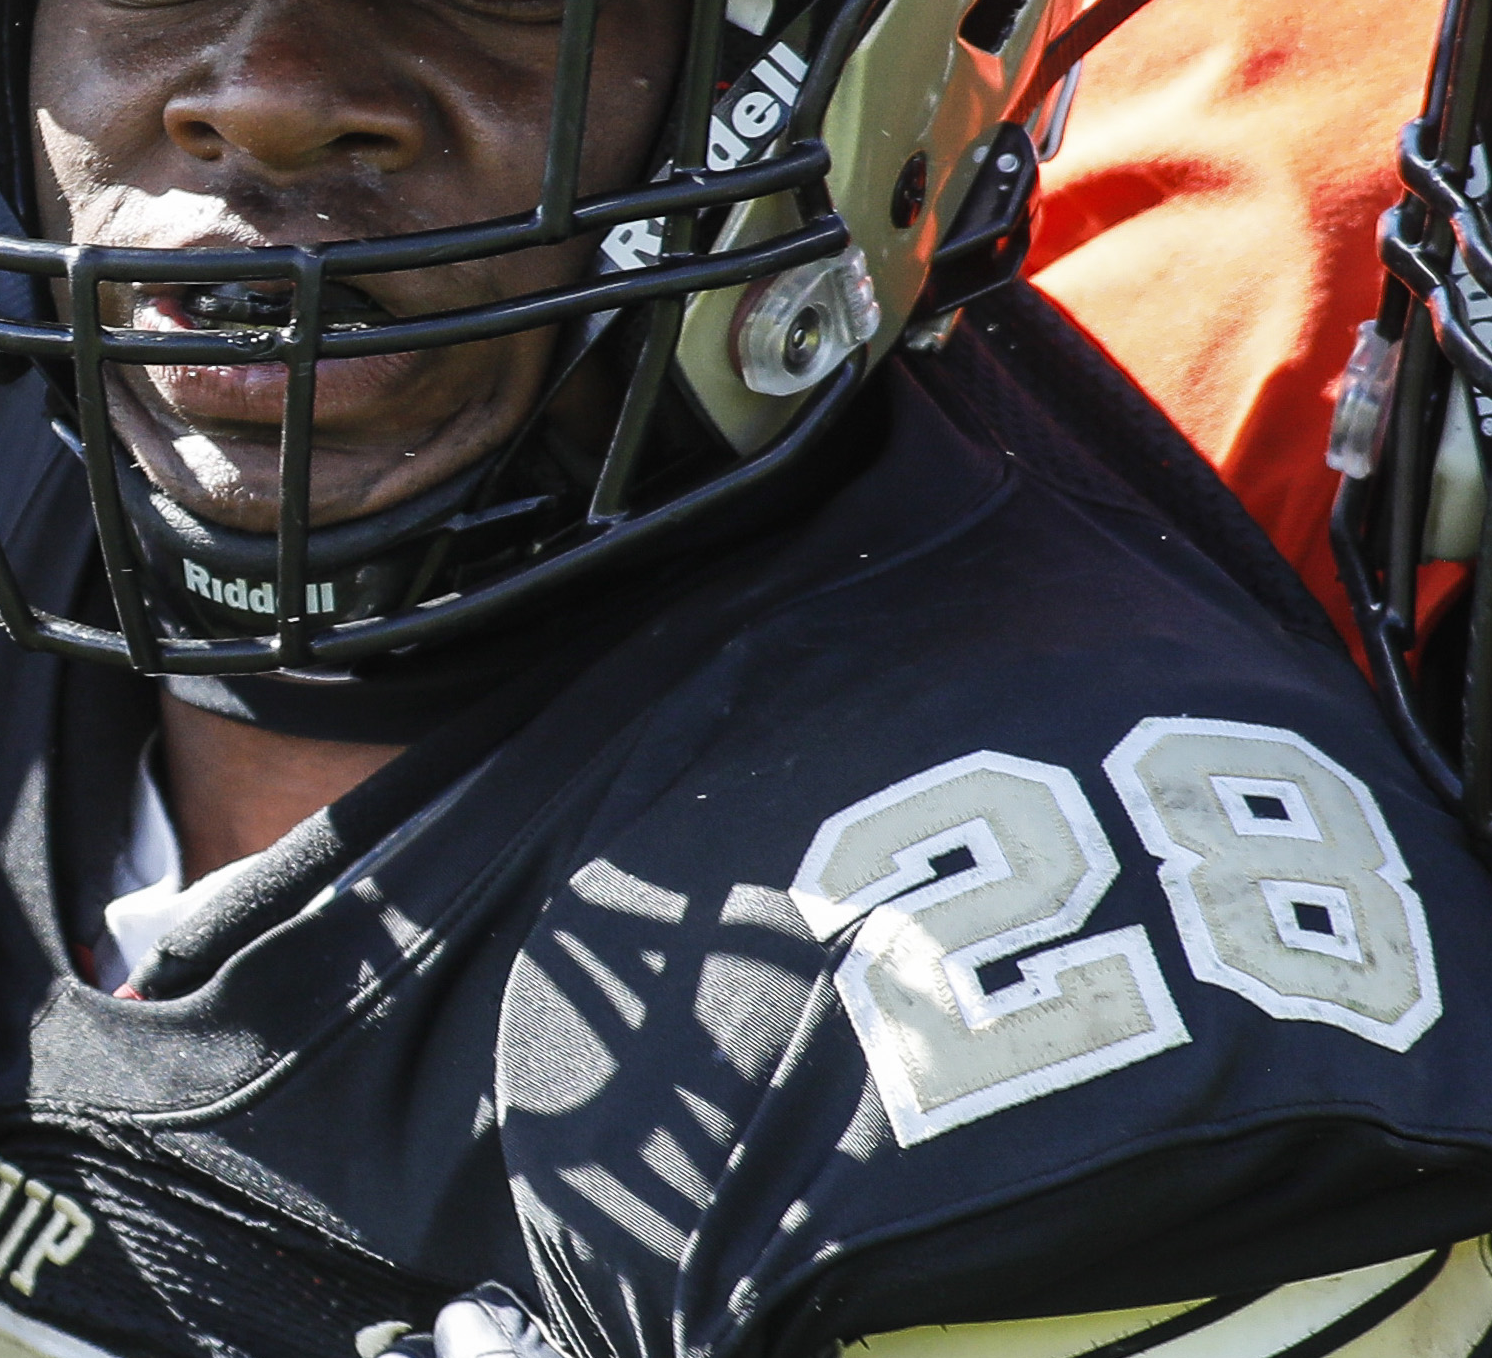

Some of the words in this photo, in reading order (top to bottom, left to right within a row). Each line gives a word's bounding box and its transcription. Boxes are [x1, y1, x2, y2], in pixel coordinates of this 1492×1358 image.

[600, 41, 809, 270] Rdell
[182, 558, 335, 614] Riddll
[788, 716, 1443, 1149] 28
